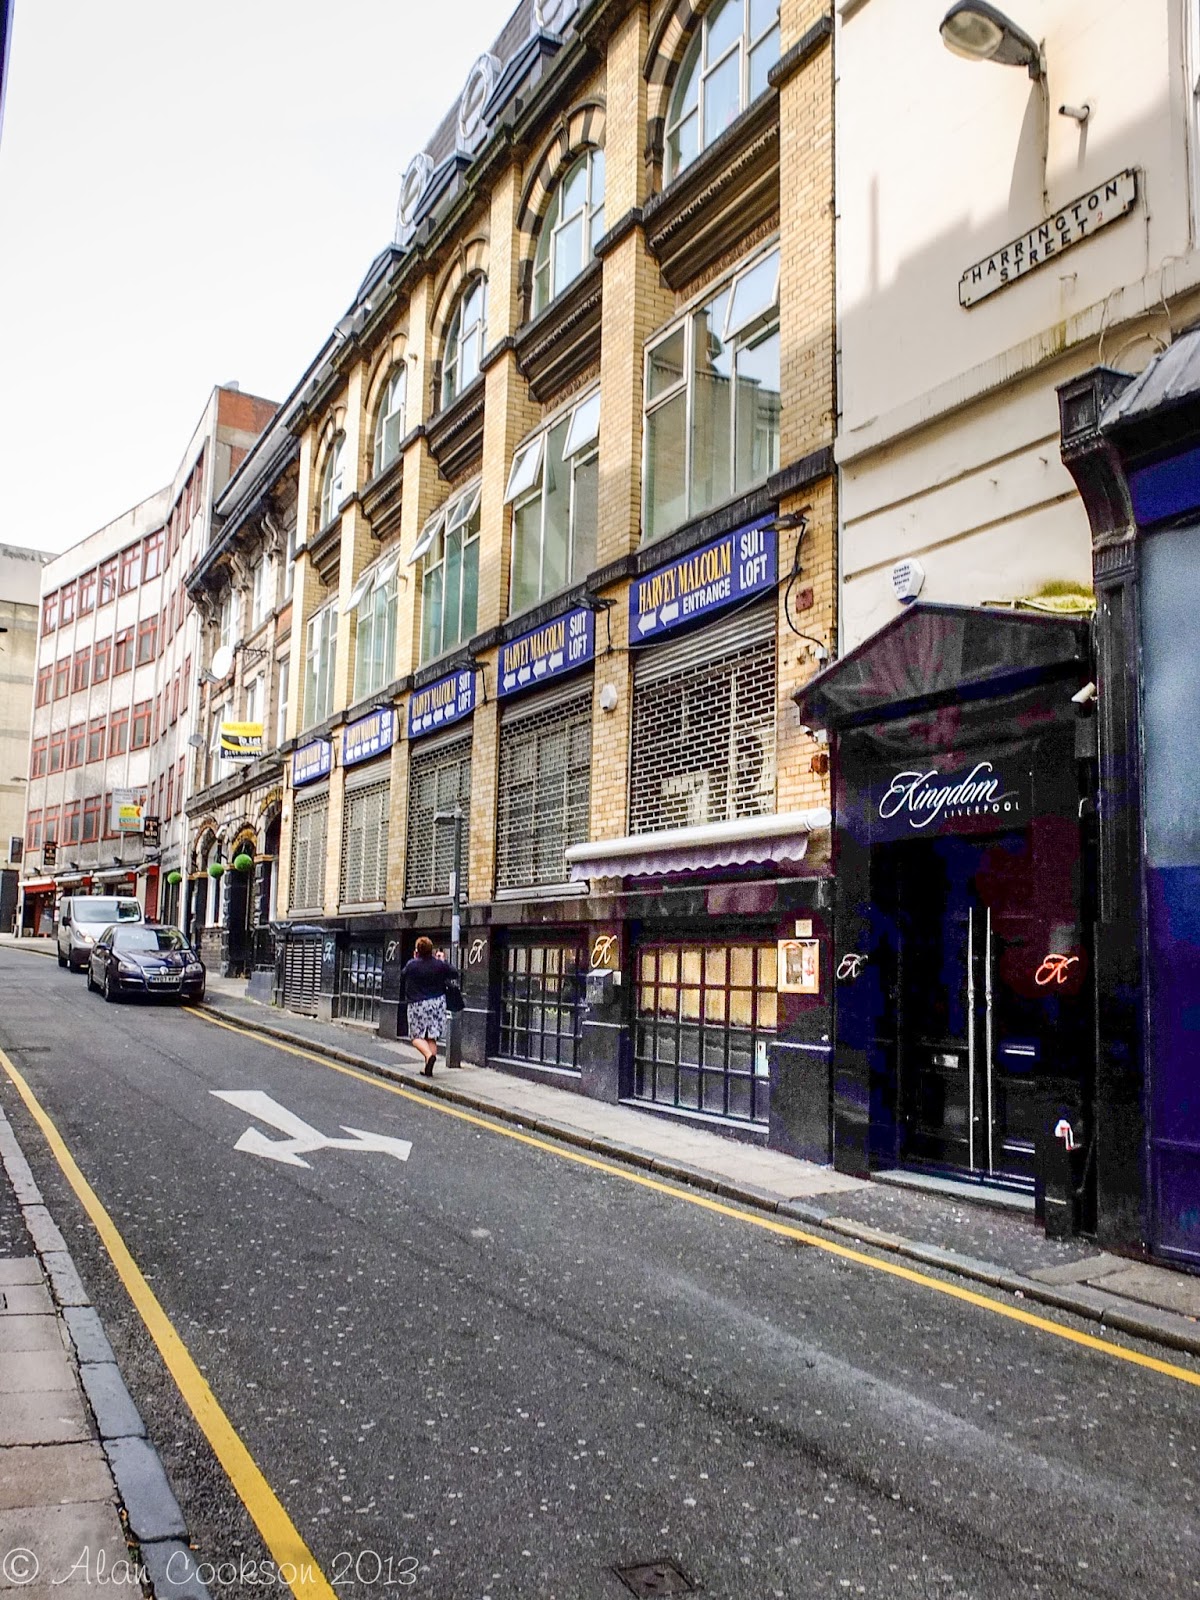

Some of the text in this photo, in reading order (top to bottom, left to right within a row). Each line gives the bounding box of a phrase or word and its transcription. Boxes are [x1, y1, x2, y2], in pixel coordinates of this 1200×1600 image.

[971, 181, 1118, 284] HARRINGTON
[999, 217, 1088, 283] STREET
[638, 541, 731, 615] HARVEY MALCOLM
[739, 554, 767, 590] LOFT
[682, 577, 731, 615] ENTRANCE
[569, 610, 587, 638] SUIT
[568, 633, 588, 661] LOFT
[458, 670, 471, 693] SUIT
[458, 689, 472, 712] LOFT
[878, 761, 1020, 828] Kingdom
[944, 801, 1020, 819] LIVERPOOL
